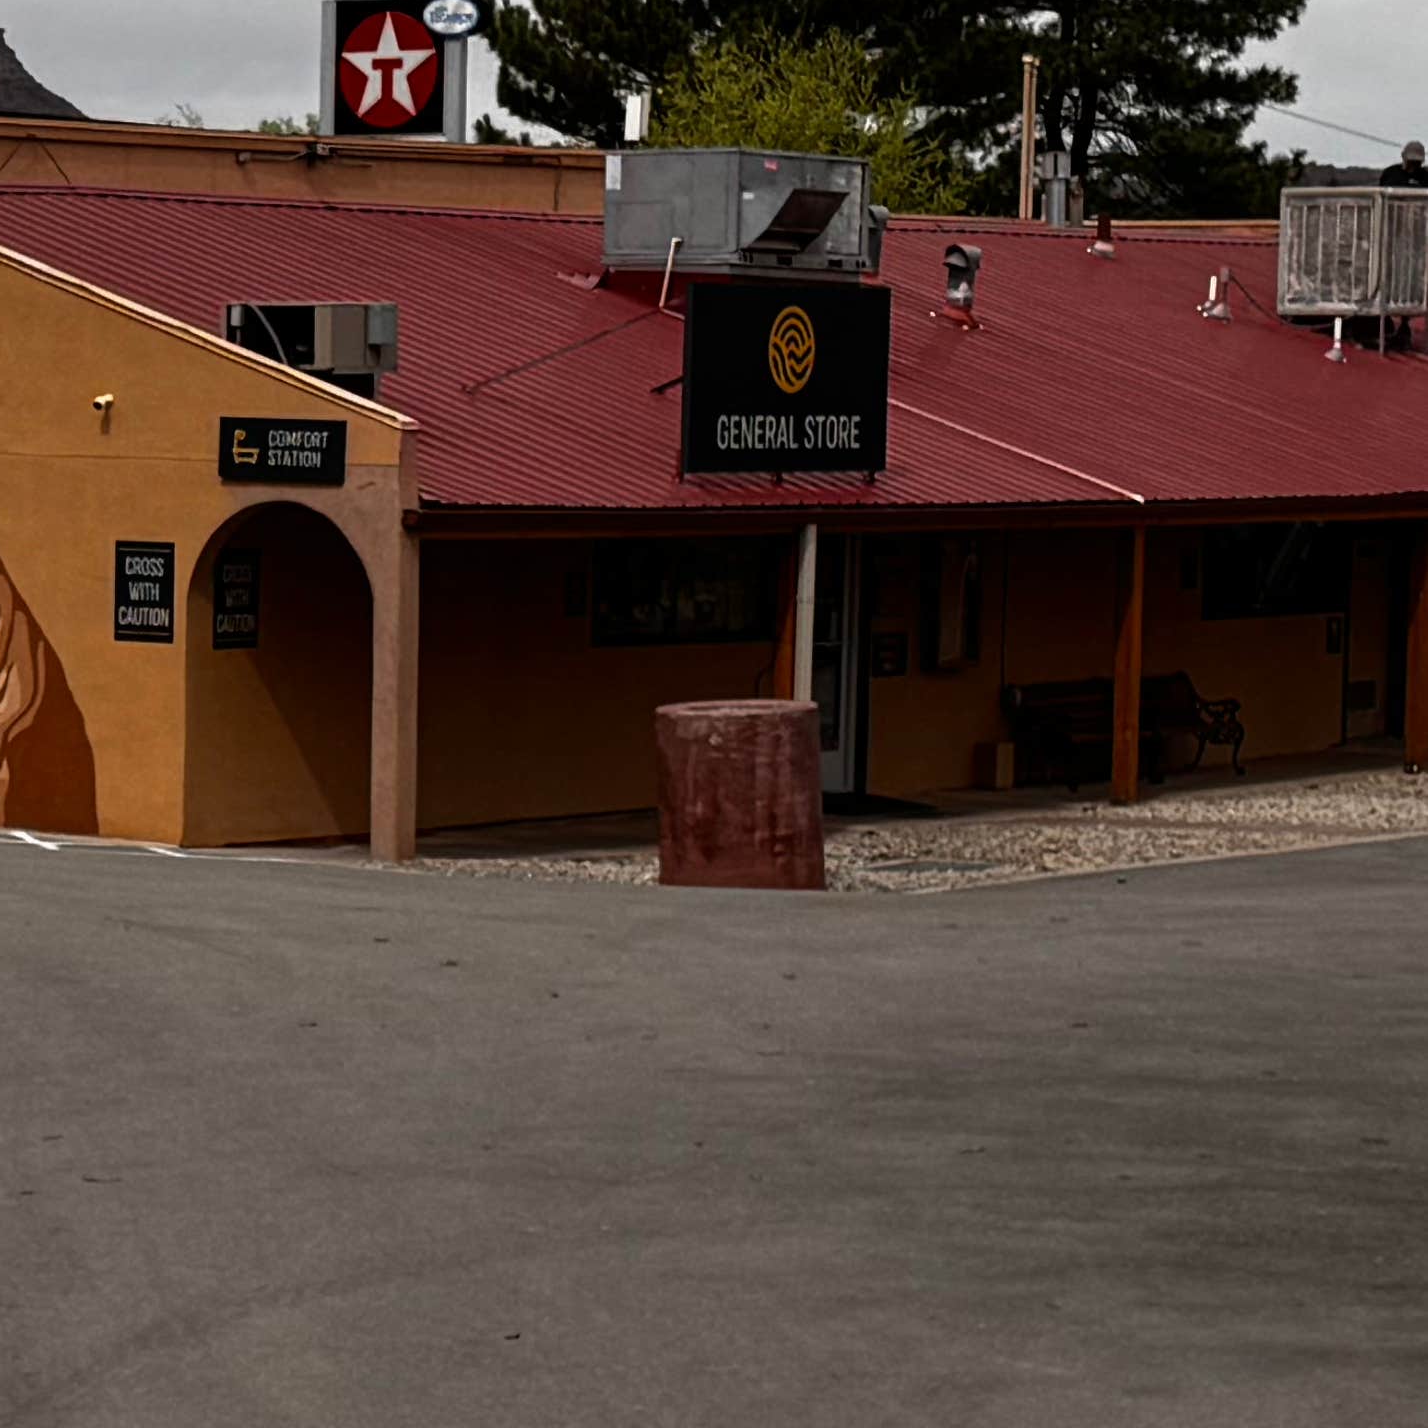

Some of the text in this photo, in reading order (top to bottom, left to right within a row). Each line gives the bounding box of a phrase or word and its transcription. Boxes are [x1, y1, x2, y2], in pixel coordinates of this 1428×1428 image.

[268, 429, 329, 448] COMFORT
[717, 414, 861, 450] GENERAL STORE
[267, 450, 322, 468] STATION
[124, 556, 166, 577] CROSS
[128, 581, 160, 602] WITH
[118, 606, 170, 628] CAUTION
[216, 613, 256, 634] CAUTION
